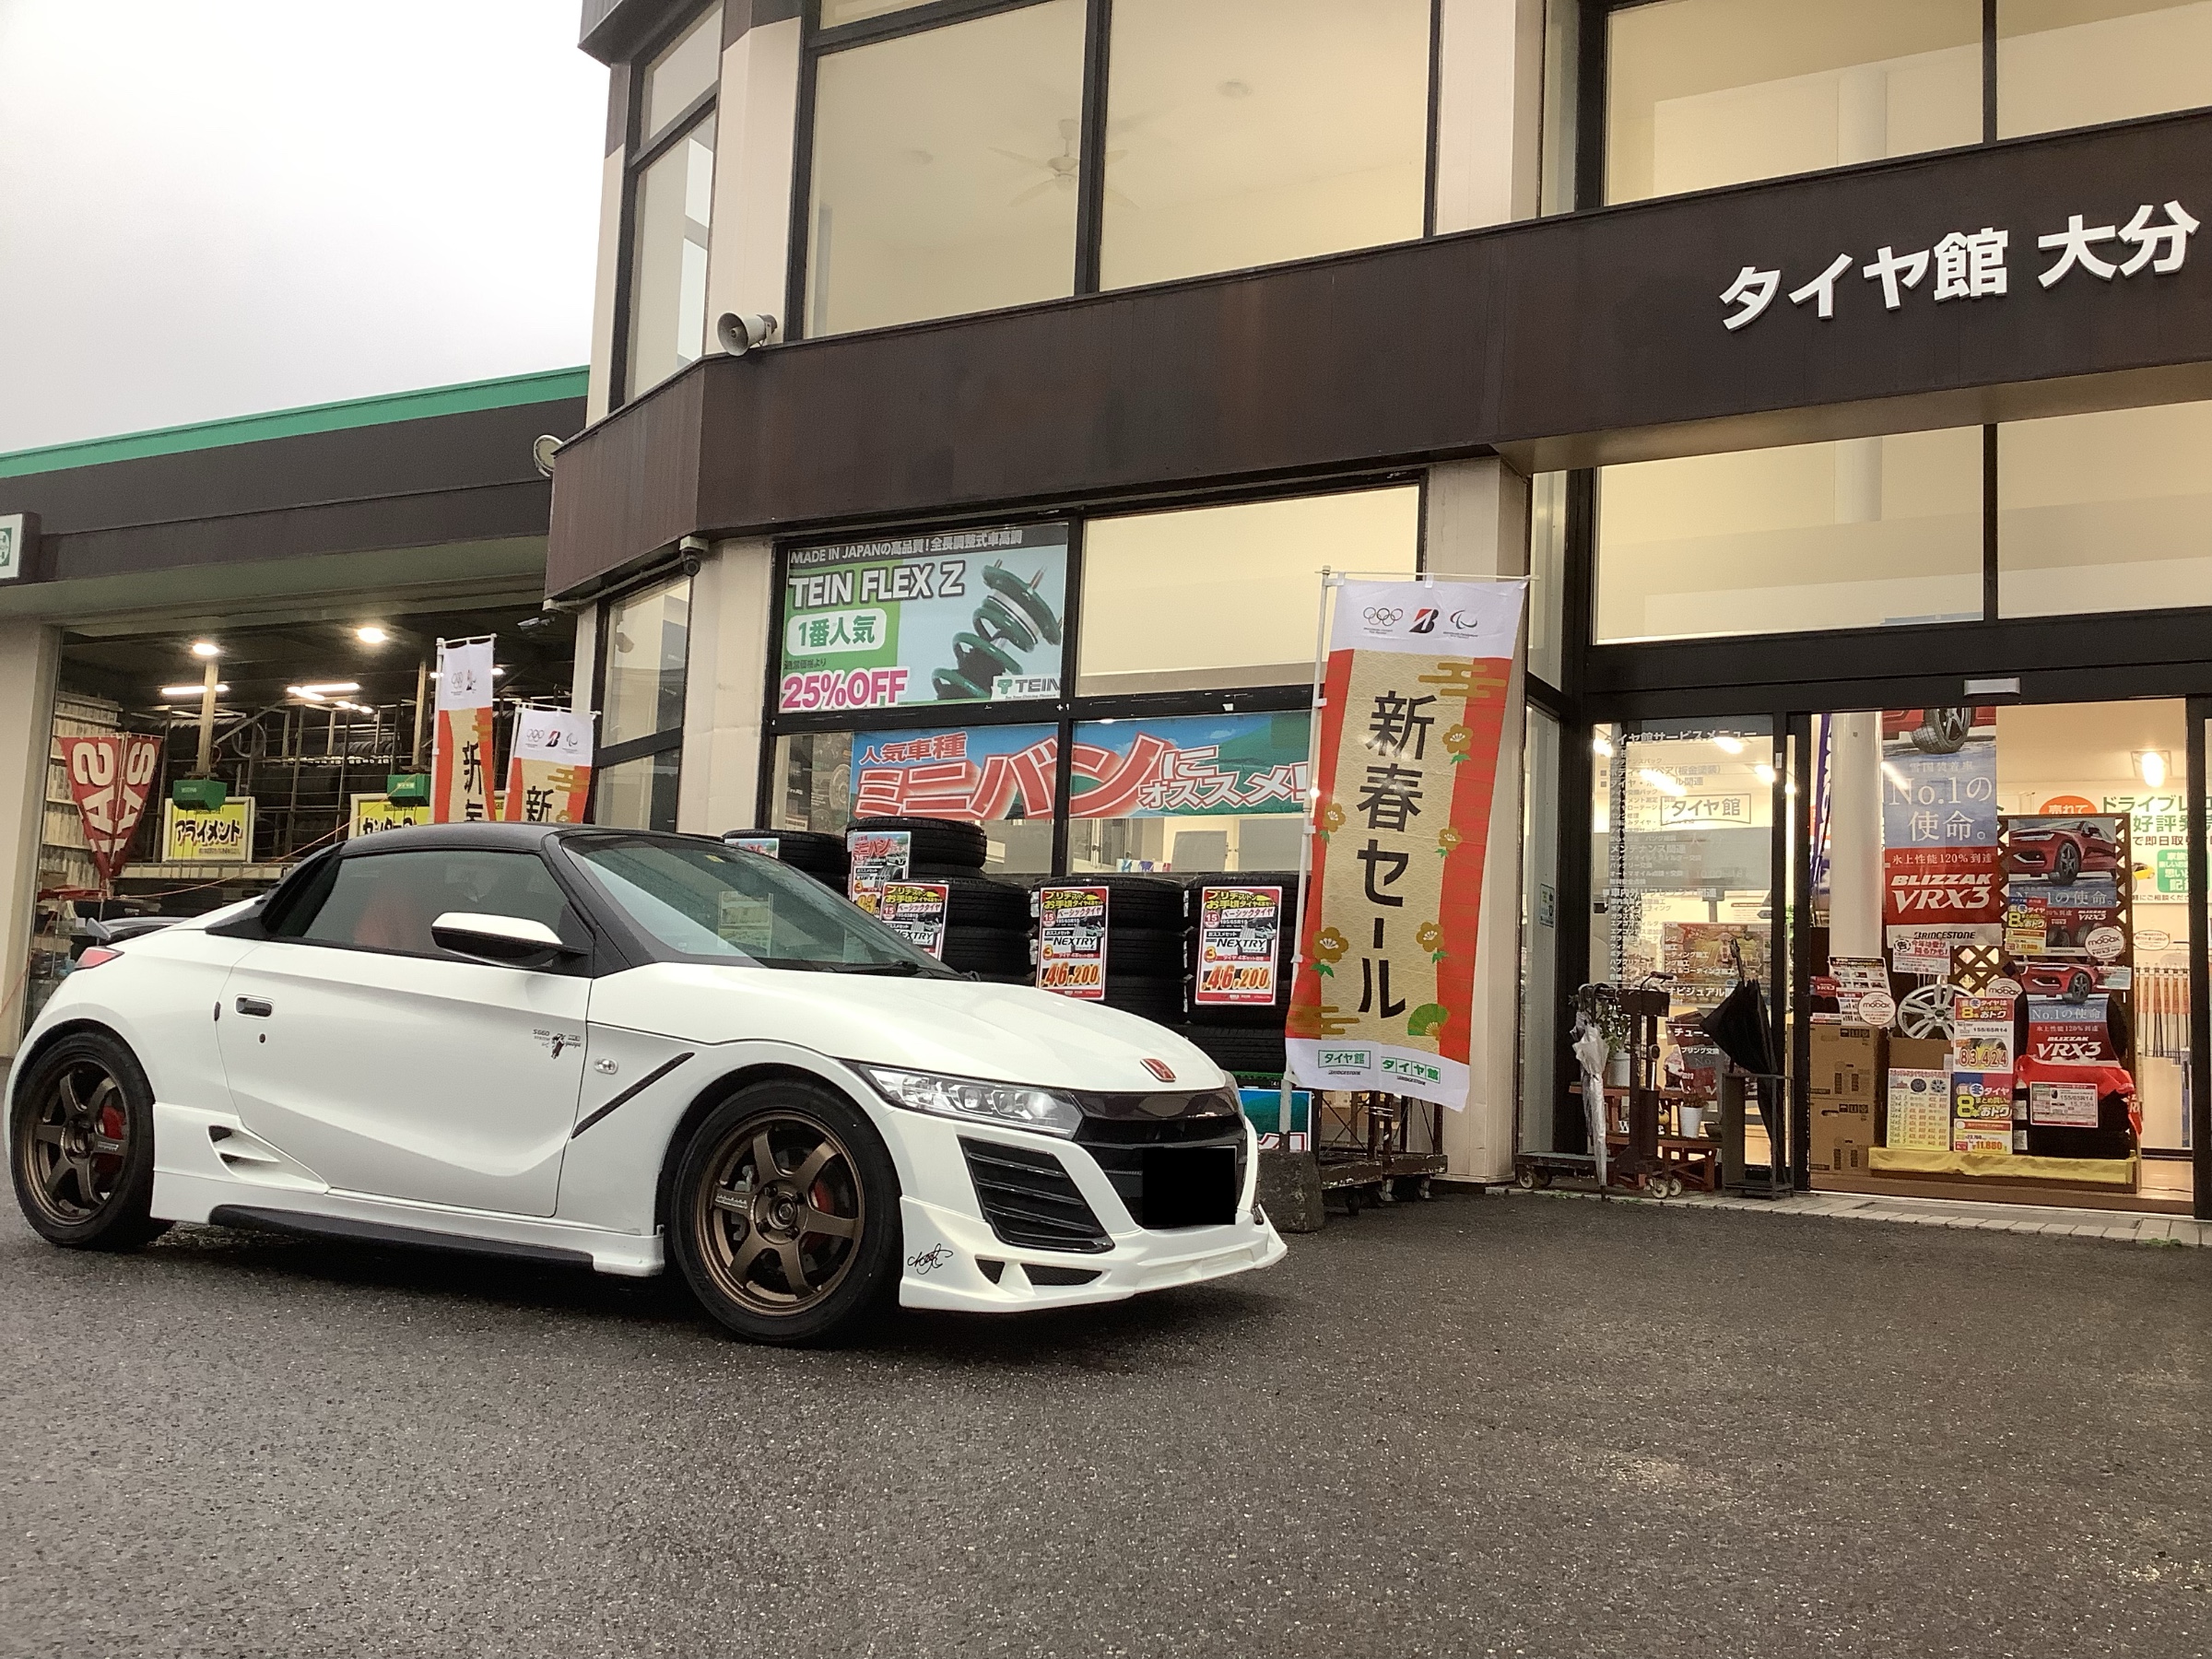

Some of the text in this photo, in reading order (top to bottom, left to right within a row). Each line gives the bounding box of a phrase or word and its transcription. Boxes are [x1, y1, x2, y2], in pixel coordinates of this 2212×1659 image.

[1719, 200, 2202, 333] タイヤ館 大分
[790, 551, 826, 564] MADE
[828, 550, 840, 560] IN
[788, 559, 965, 607] TEIN FLEX Z
[798, 615, 877, 647] 1番人気
[782, 669, 908, 708] 25%OFF
[859, 731, 968, 765] 人気車種
[1889, 776, 1993, 806] No.1の
[1671, 797, 1742, 818] タイヤ館
[2049, 804, 2088, 815] 売れて
[1907, 809, 1986, 841] 使命。
[175, 818, 242, 846] アライメント
[1356, 690, 1438, 1020] 新春セール
[1610, 844, 1687, 854] メンテナンス関連
[1890, 874, 1994, 887] BLIZZAK
[1892, 886, 1993, 913] VRX3
[884, 906, 894, 915] 15
[1057, 906, 1102, 917] ベーシックタイヤ
[1222, 907, 1274, 918] ベーシックタイヤ
[1043, 913, 1053, 922] 15
[1206, 913, 1218, 922] 15
[1053, 936, 1096, 946] NEXTRY
[1913, 931, 1976, 940] BRIDGESTONE
[1217, 938, 1266, 947] NEXTRY
[1980, 1010, 2007, 1018] おトク
[2031, 1007, 2101, 1020] No.1の使命
[2036, 1041, 2102, 1059] VRX3
[1324, 1053, 1441, 1082] タイヤ館 タイヤ館
[1980, 1106, 2010, 1117] おトク
